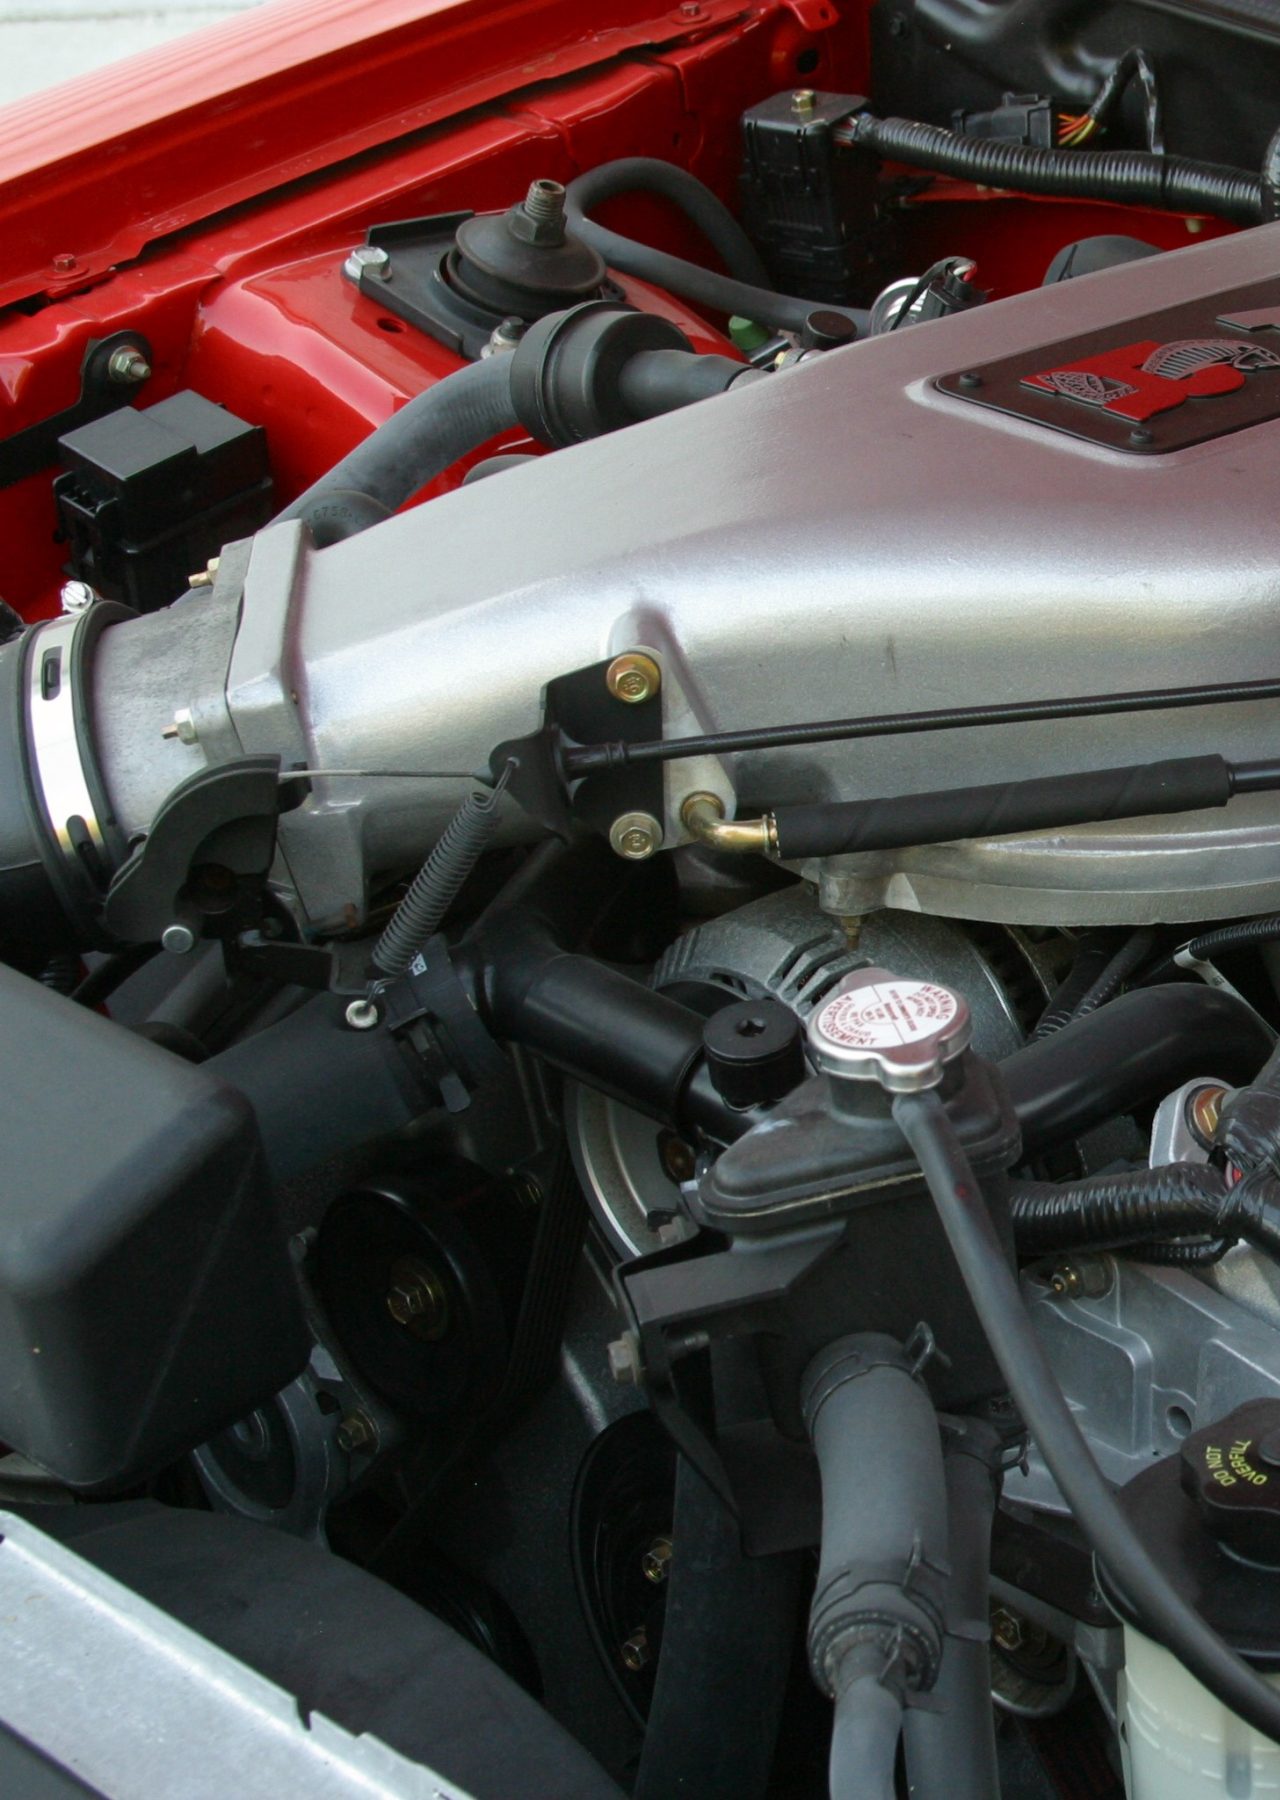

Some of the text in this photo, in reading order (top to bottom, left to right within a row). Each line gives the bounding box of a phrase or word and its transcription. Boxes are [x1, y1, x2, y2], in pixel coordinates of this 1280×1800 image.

[822, 995, 877, 1045] AVERTISSEMENT
[920, 985, 954, 1019] WARNING
[1205, 1446, 1236, 1487] DO NOT
[1229, 1439, 1268, 1486] OVERFILL
